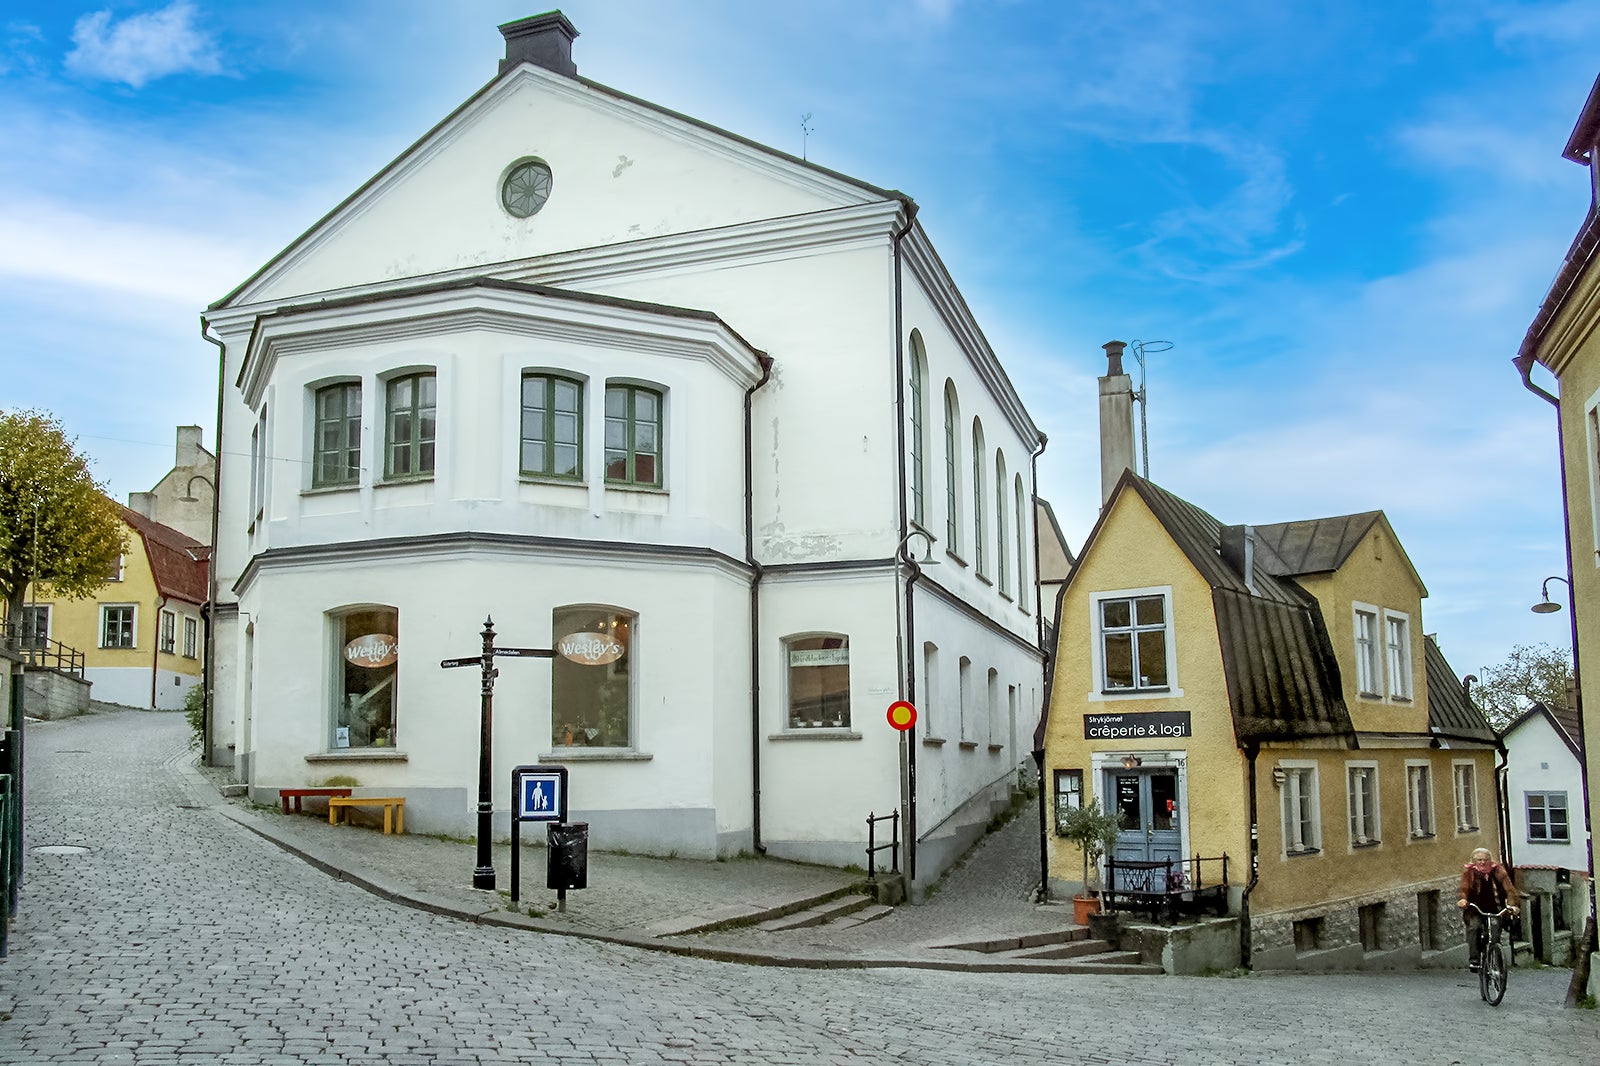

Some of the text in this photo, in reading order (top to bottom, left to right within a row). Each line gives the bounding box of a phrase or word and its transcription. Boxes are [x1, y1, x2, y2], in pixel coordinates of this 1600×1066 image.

[561, 639, 620, 656] Wesley's
[1089, 722, 1185, 739] crêperie & logi
[1177, 759, 1185, 767] 16
